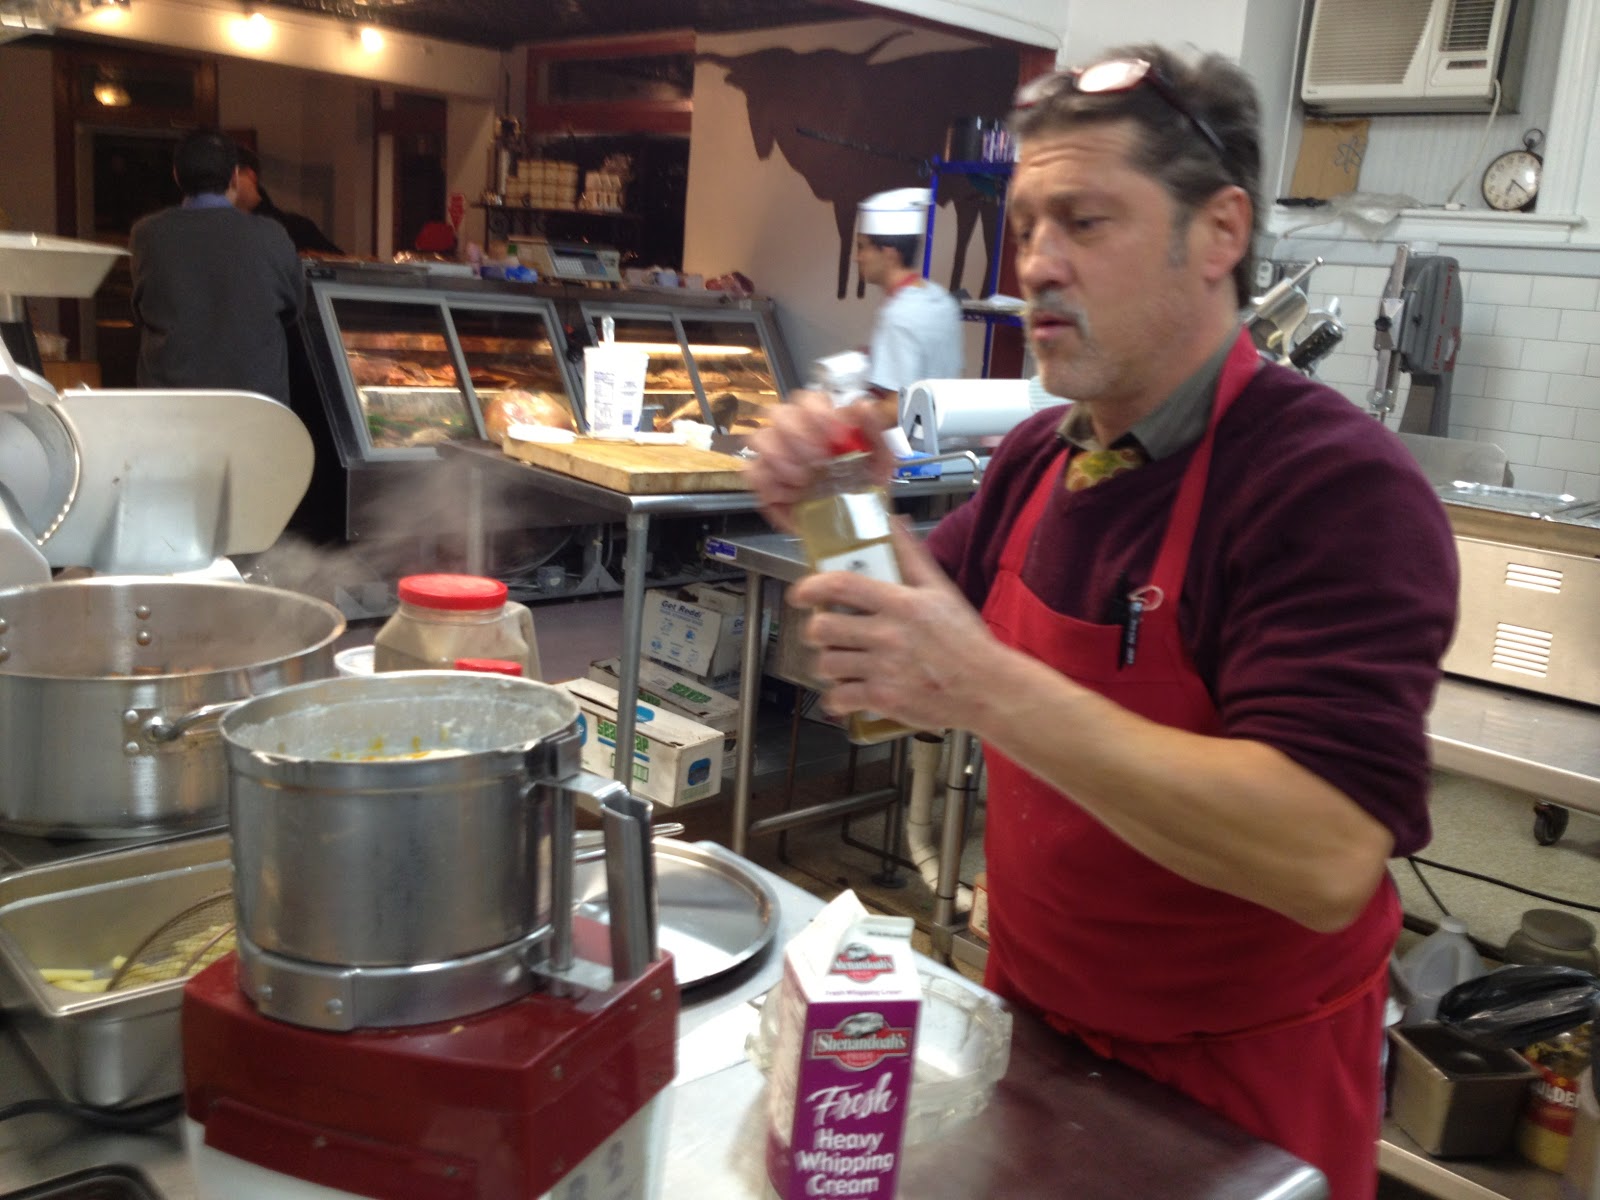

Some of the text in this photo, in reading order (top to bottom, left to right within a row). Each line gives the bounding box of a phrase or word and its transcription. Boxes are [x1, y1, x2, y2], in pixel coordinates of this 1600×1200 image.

[661, 600, 677, 610] Get
[805, 1072, 898, 1126] Fresh
[814, 1128, 884, 1155] Heavy
[795, 1150, 894, 1177] Whipping
[806, 1174, 880, 1196] Cream
